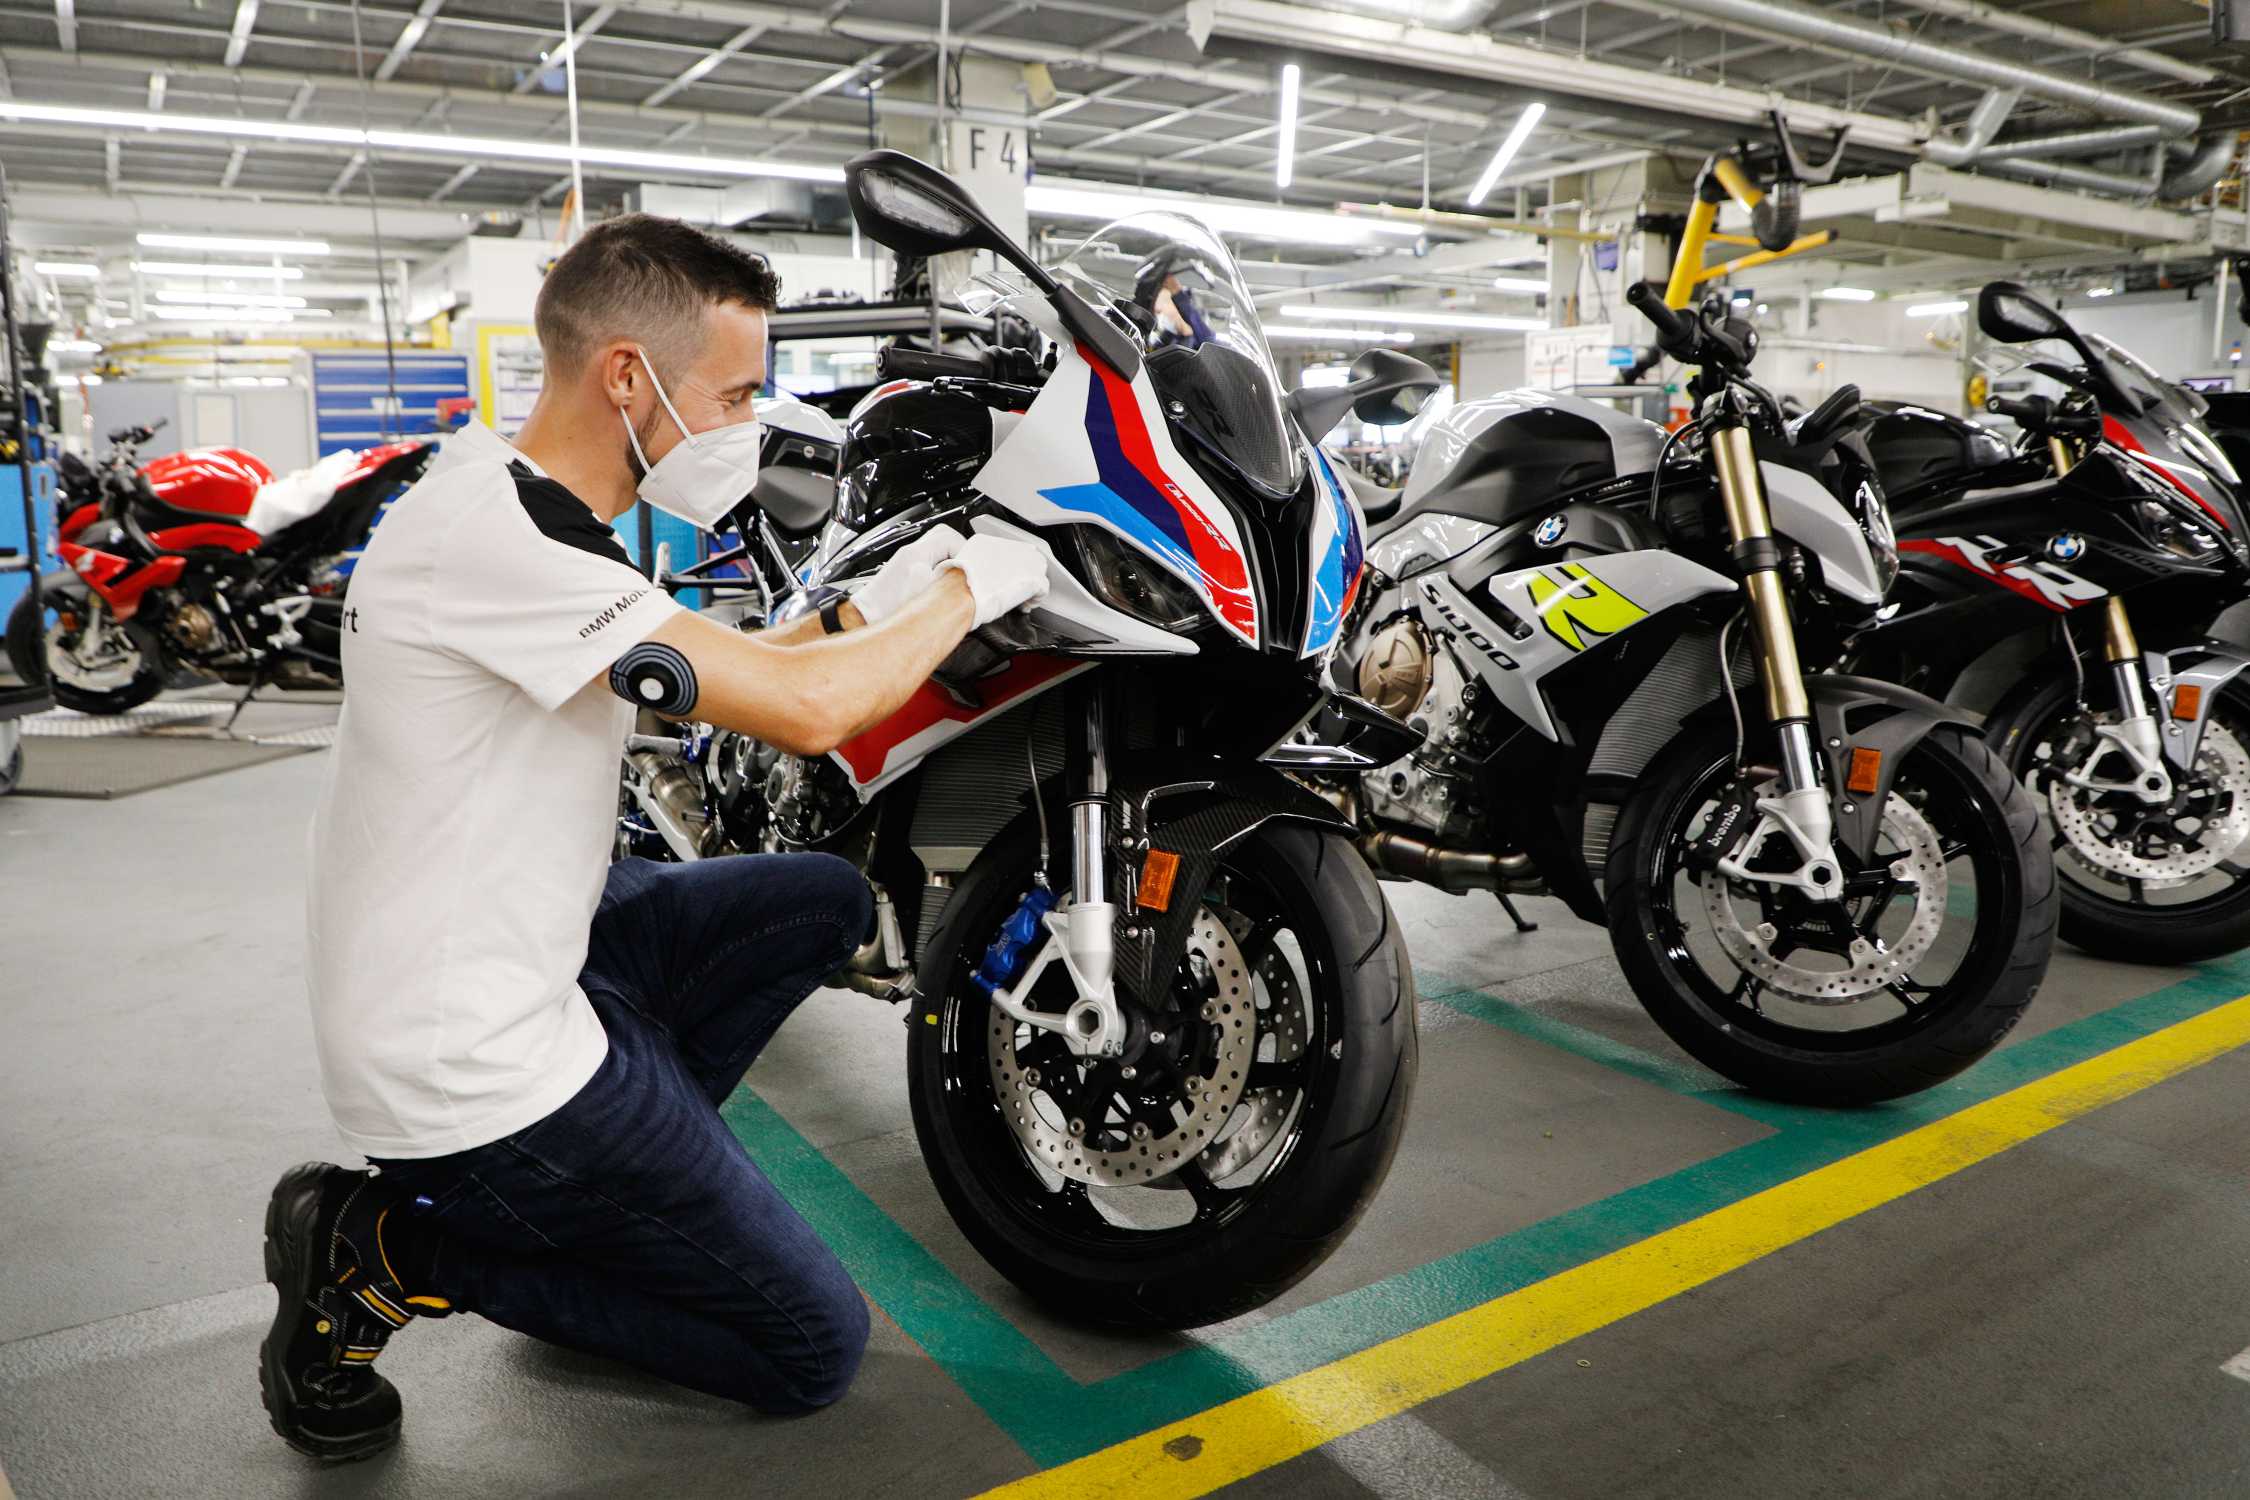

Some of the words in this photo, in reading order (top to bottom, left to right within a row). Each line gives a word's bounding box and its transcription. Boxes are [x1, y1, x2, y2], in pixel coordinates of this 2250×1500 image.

[578, 607, 616, 638] BMW
[1420, 583, 1520, 671] S1000
[1707, 804, 1741, 847] brembo
